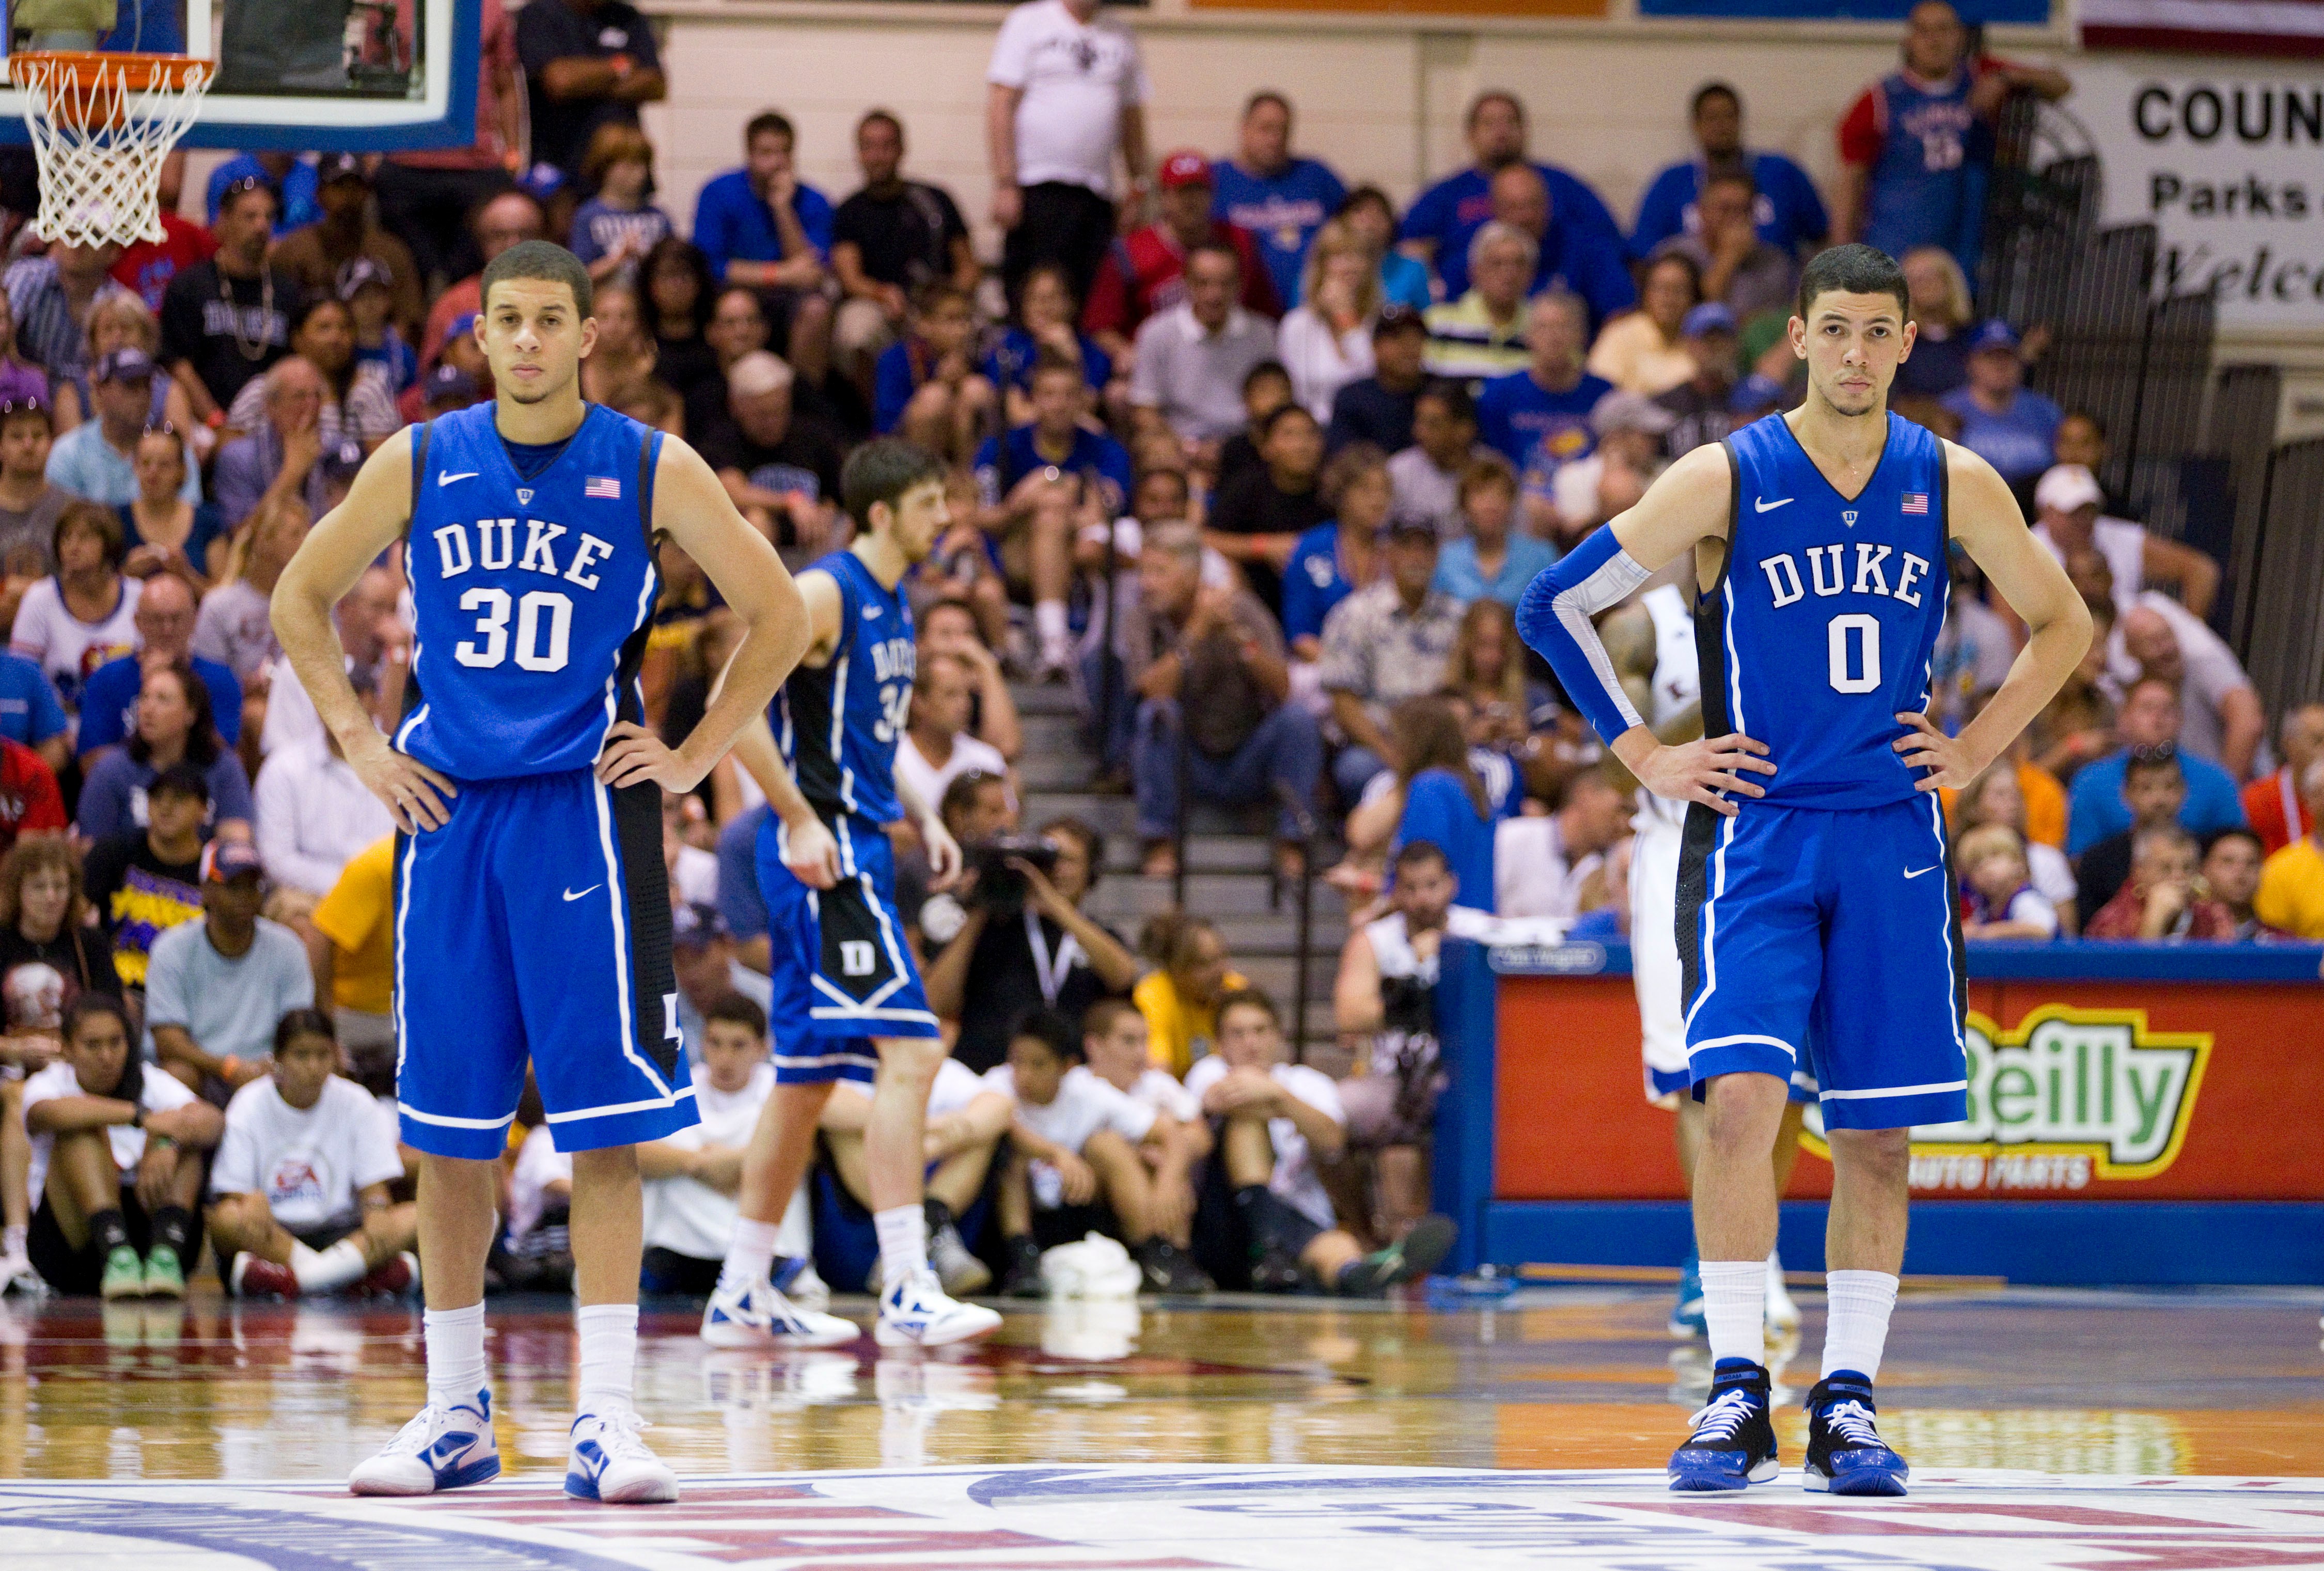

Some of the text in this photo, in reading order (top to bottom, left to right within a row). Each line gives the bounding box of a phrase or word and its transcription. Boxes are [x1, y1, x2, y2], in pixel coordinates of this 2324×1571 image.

[2136, 87, 2323, 142] COUN
[2152, 172, 2306, 217] Parks
[433, 518, 615, 591] DUKE
[1759, 542, 1929, 609] DUKE
[454, 587, 574, 672] 30
[1828, 613, 1881, 694] 0
[839, 940, 876, 976] D
